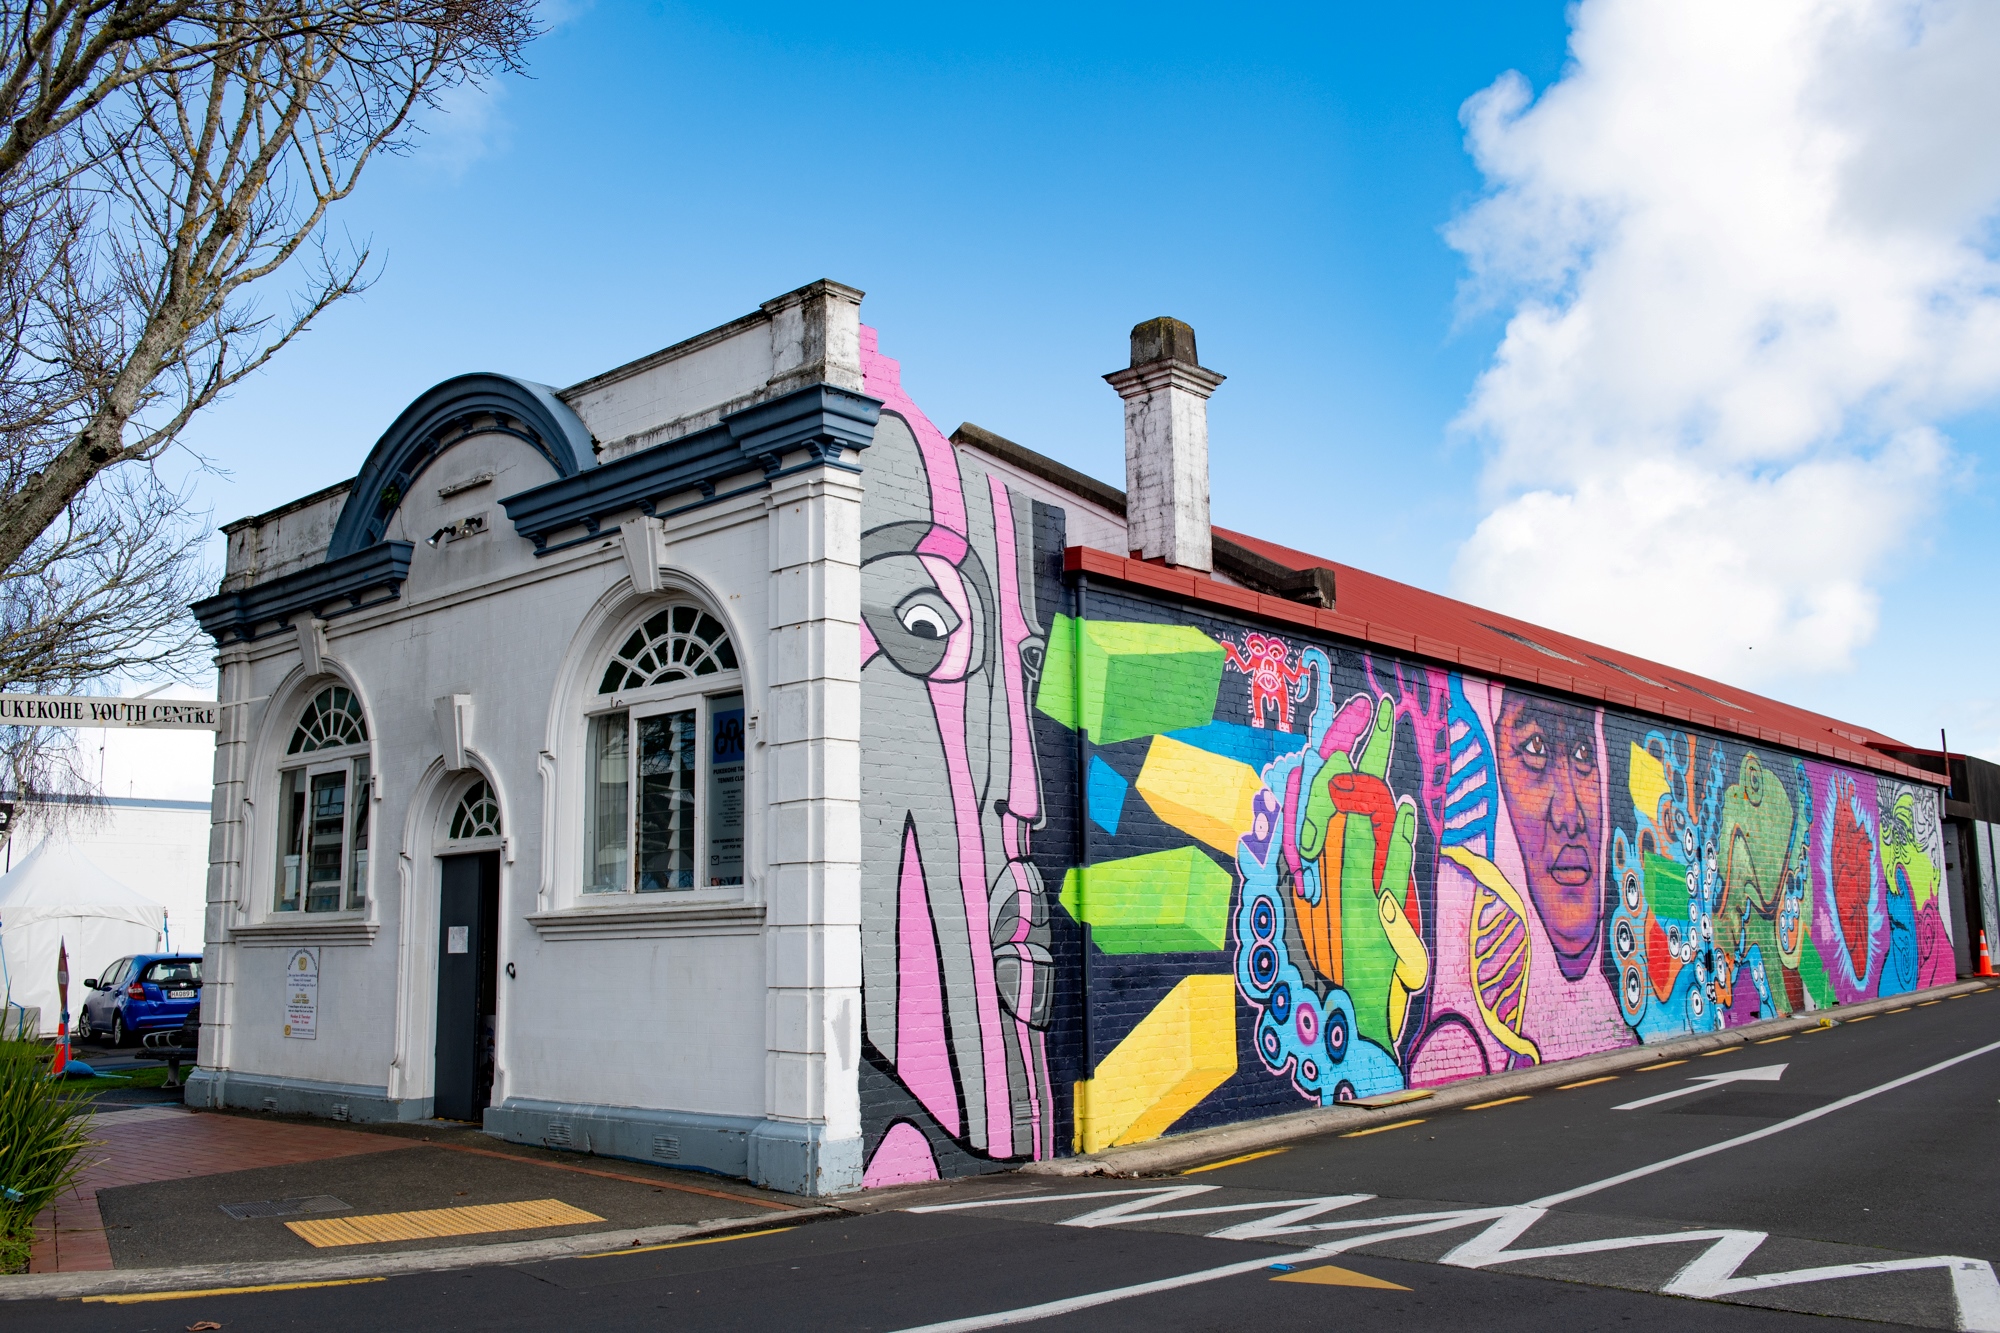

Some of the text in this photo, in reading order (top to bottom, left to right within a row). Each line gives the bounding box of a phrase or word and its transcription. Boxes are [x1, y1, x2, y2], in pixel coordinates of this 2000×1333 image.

[90, 703, 147, 721] YOUTH
[152, 705, 216, 723] CENTRE
[713, 767, 736, 775] PUKEKOHE
[717, 776, 734, 784] TENNIS
